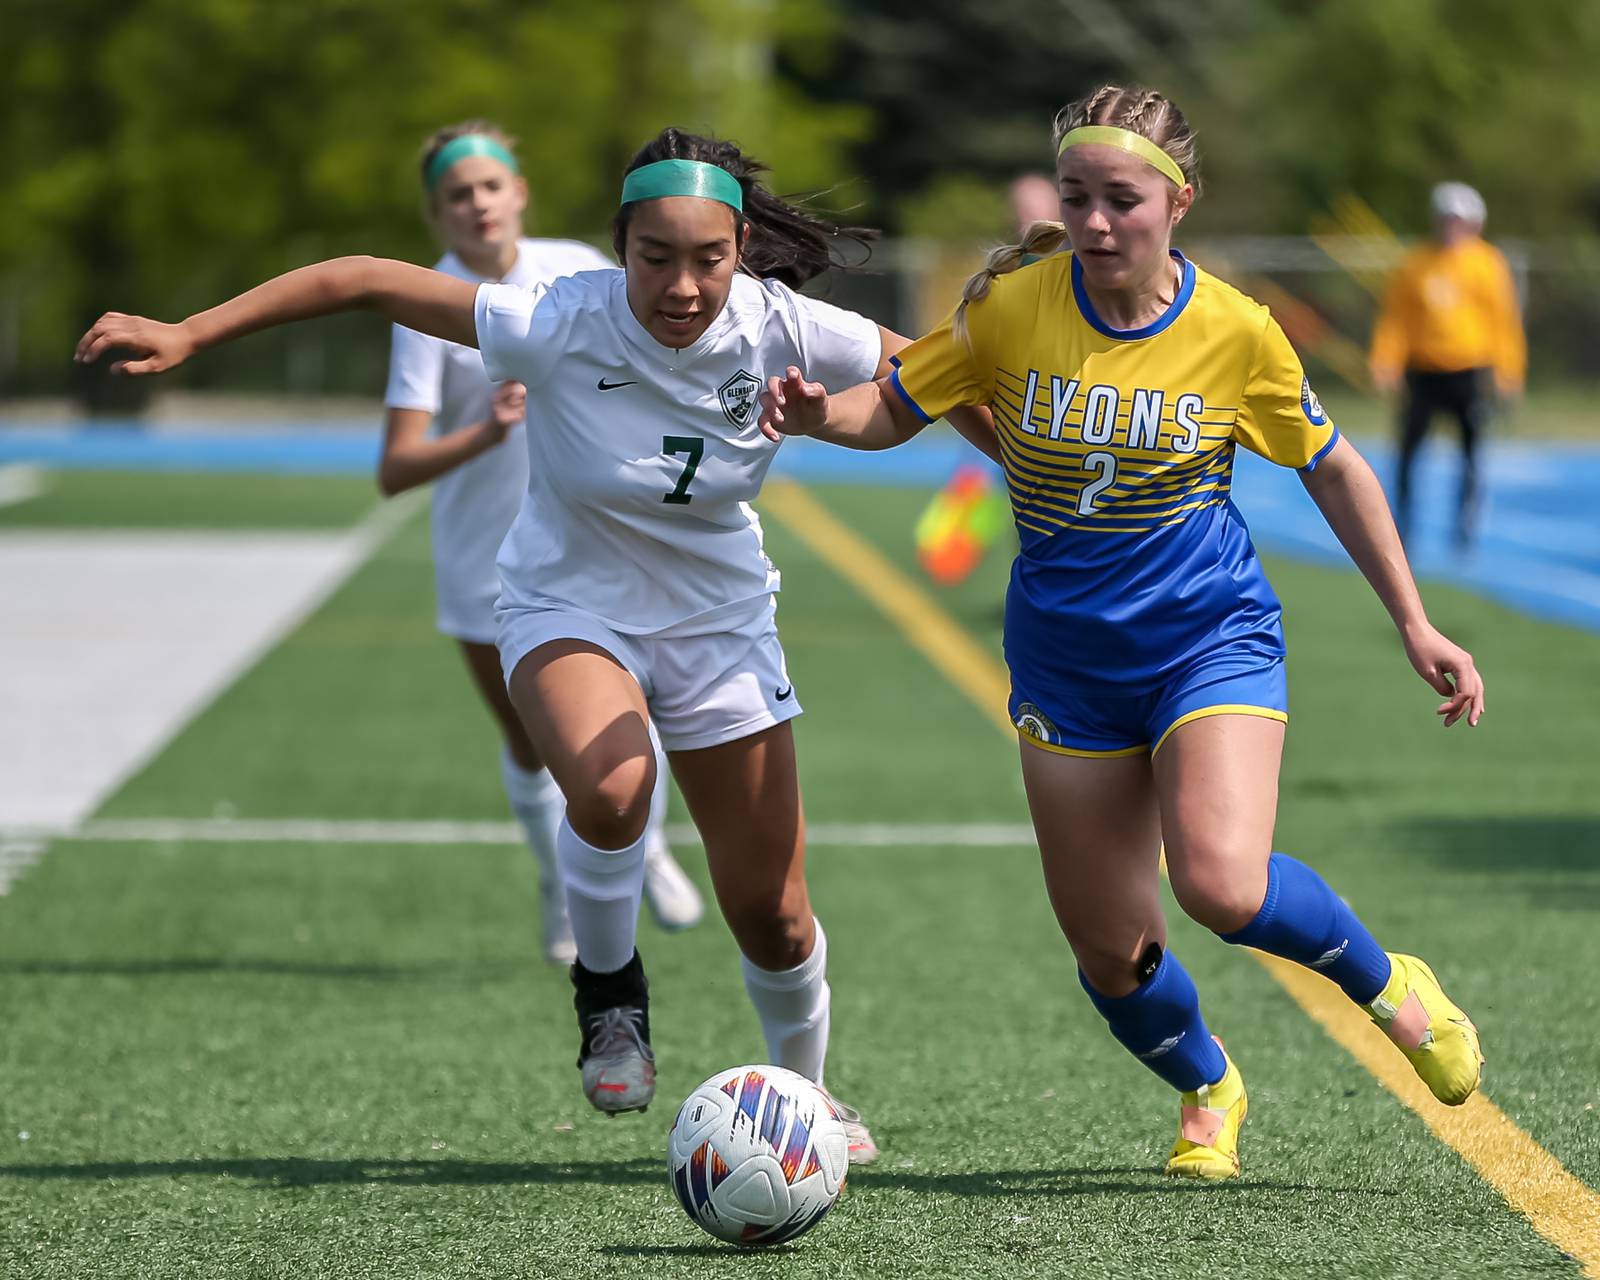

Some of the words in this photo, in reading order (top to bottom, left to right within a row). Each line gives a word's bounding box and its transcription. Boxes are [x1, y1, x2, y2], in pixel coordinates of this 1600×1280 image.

[1019, 367, 1204, 454] LYONS
[662, 435, 704, 506] 7
[1076, 450, 1119, 517] 2
